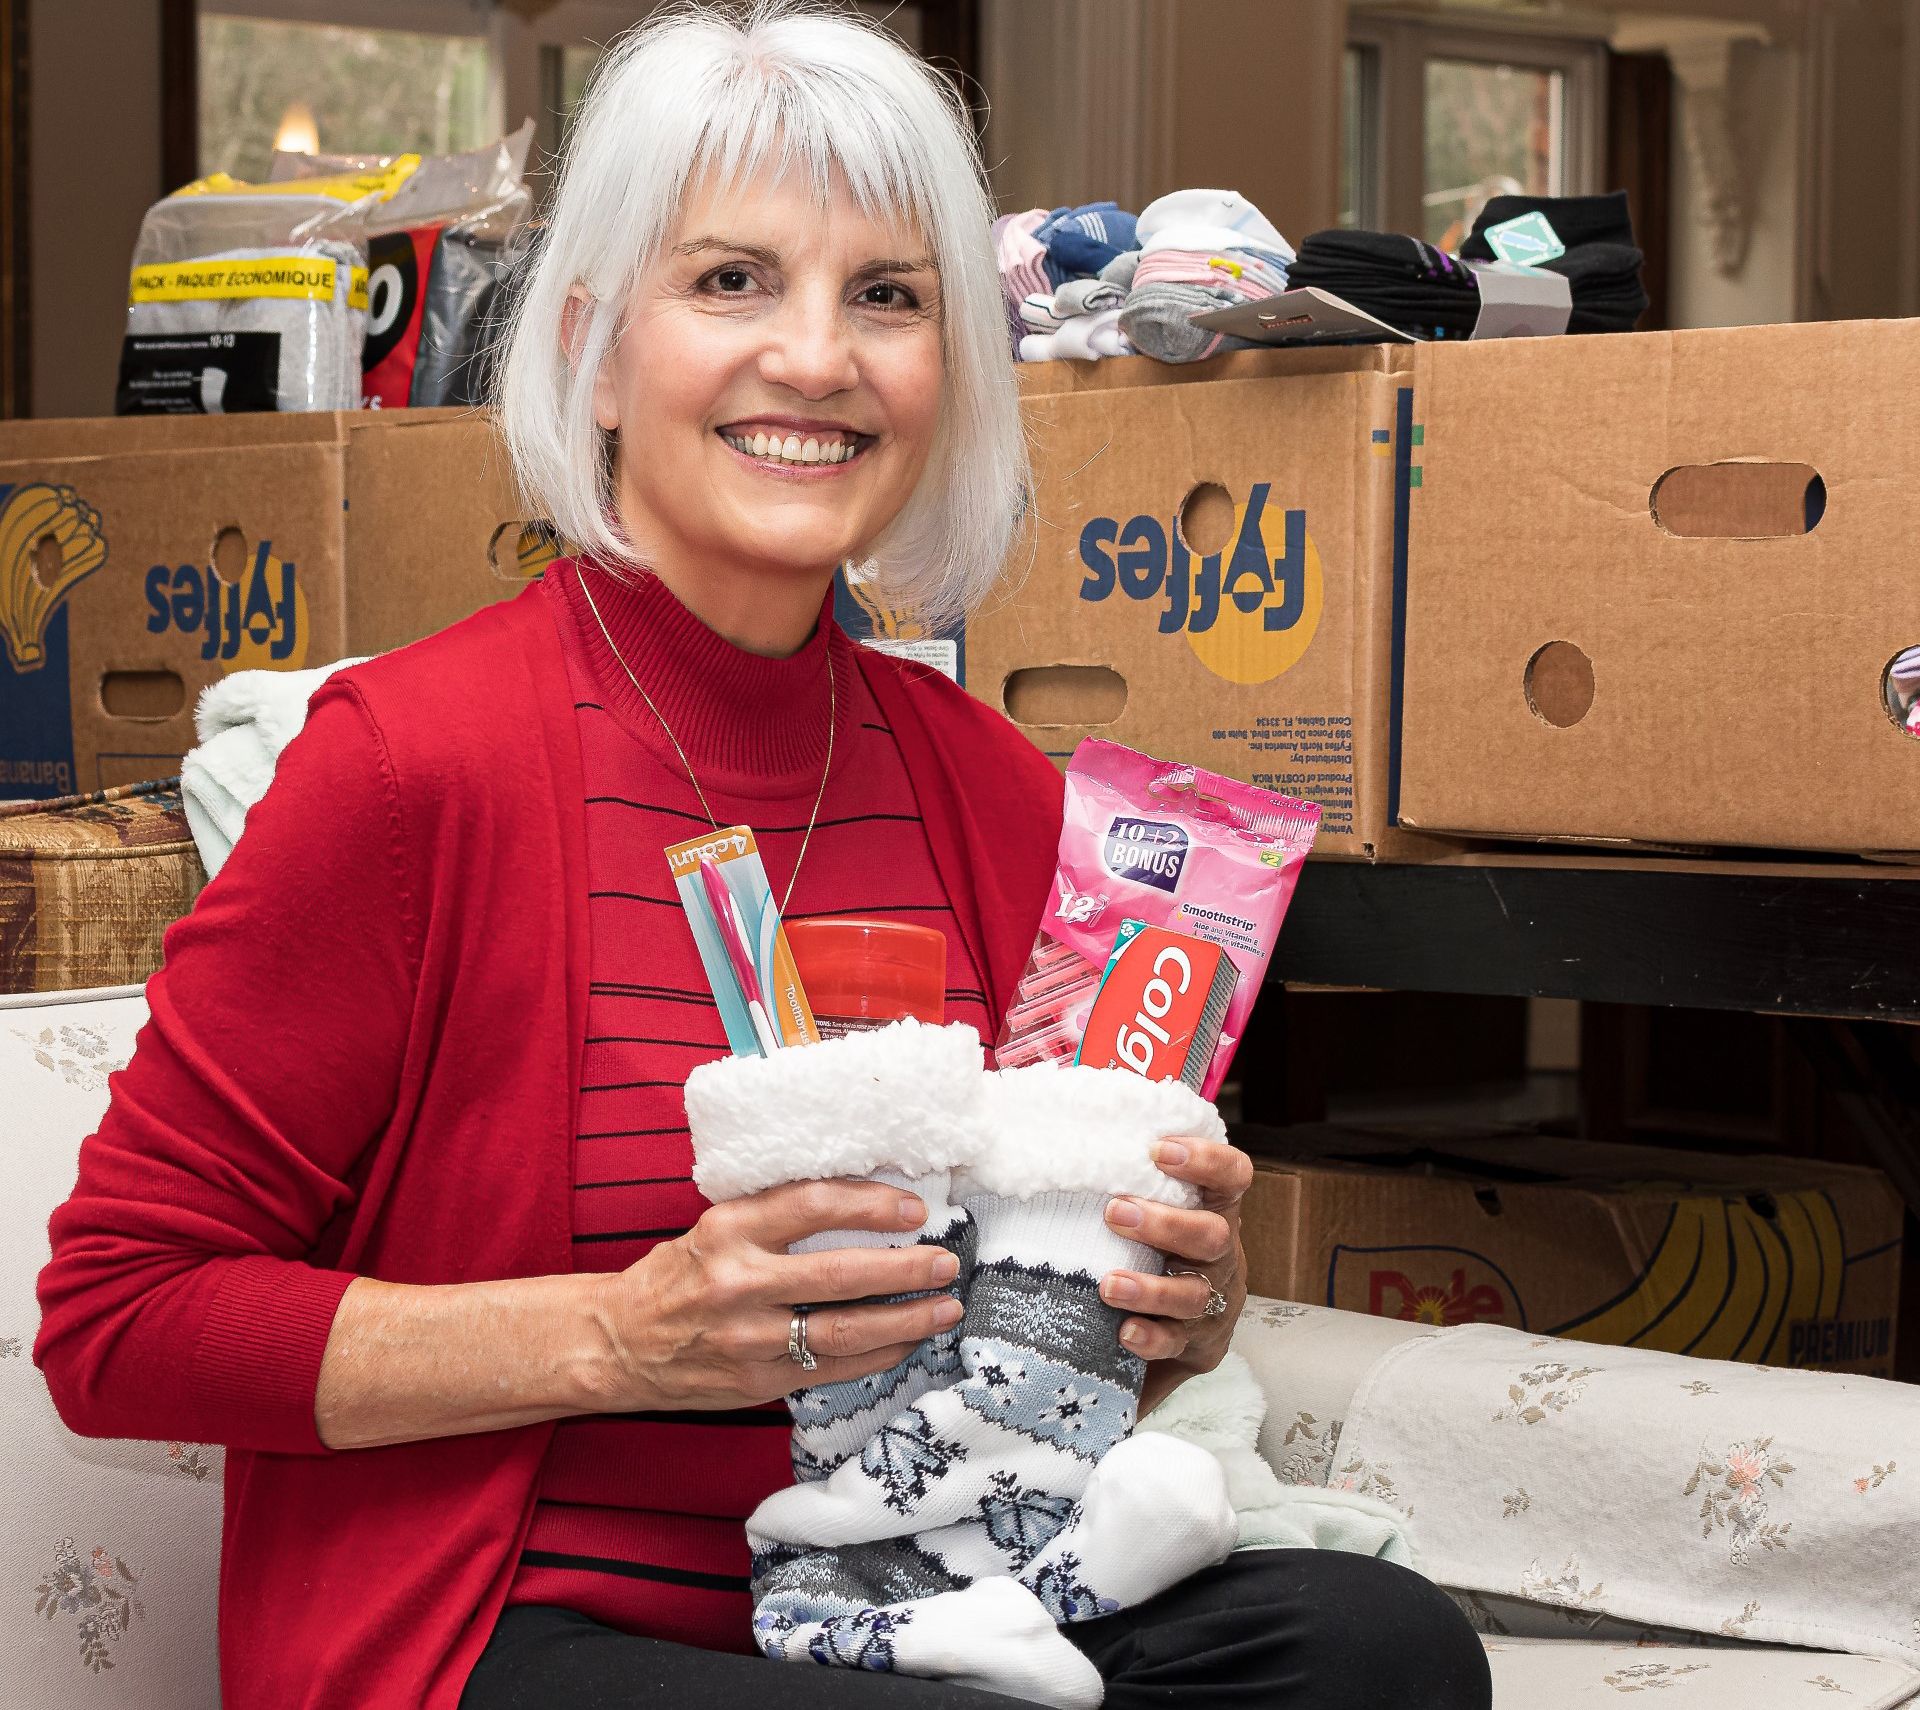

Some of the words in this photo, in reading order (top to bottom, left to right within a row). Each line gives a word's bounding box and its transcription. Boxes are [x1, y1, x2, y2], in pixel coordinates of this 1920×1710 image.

[176, 272, 224, 288] PAQUET
[1282, 717, 1293, 726] FL
[1297, 716, 1326, 727] Gables,
[1327, 716, 1352, 726] Coral
[1228, 730, 1248, 740] Suite
[1272, 730, 1293, 739] Leon
[1295, 730, 1307, 739] De
[1308, 730, 1334, 739] Ponce
[1264, 741, 1298, 751] America
[1300, 742, 1323, 751] North
[1290, 754, 1304, 763] by:
[1305, 755, 1352, 764] Distributed
[1252, 774, 1273, 783] RICA
[1274, 774, 1305, 783] COSTA
[1307, 774, 1316, 783] of
[1317, 774, 1352, 783] Product
[1305, 785, 1334, 796] weight:
[1336, 786, 1352, 796] Net
[1325, 812, 1353, 821] Class:
[1320, 824, 1354, 834] Variety:
[1111, 842, 1180, 878] BONUS
[1193, 921, 1210, 932] Aloe
[1211, 926, 1224, 935] and
[1225, 929, 1252, 943] Vitamin
[785, 983, 811, 1045] Toothbrus
[1116, 945, 1192, 1078] Colg
[1788, 1316, 1890, 1367] PREMIUM
